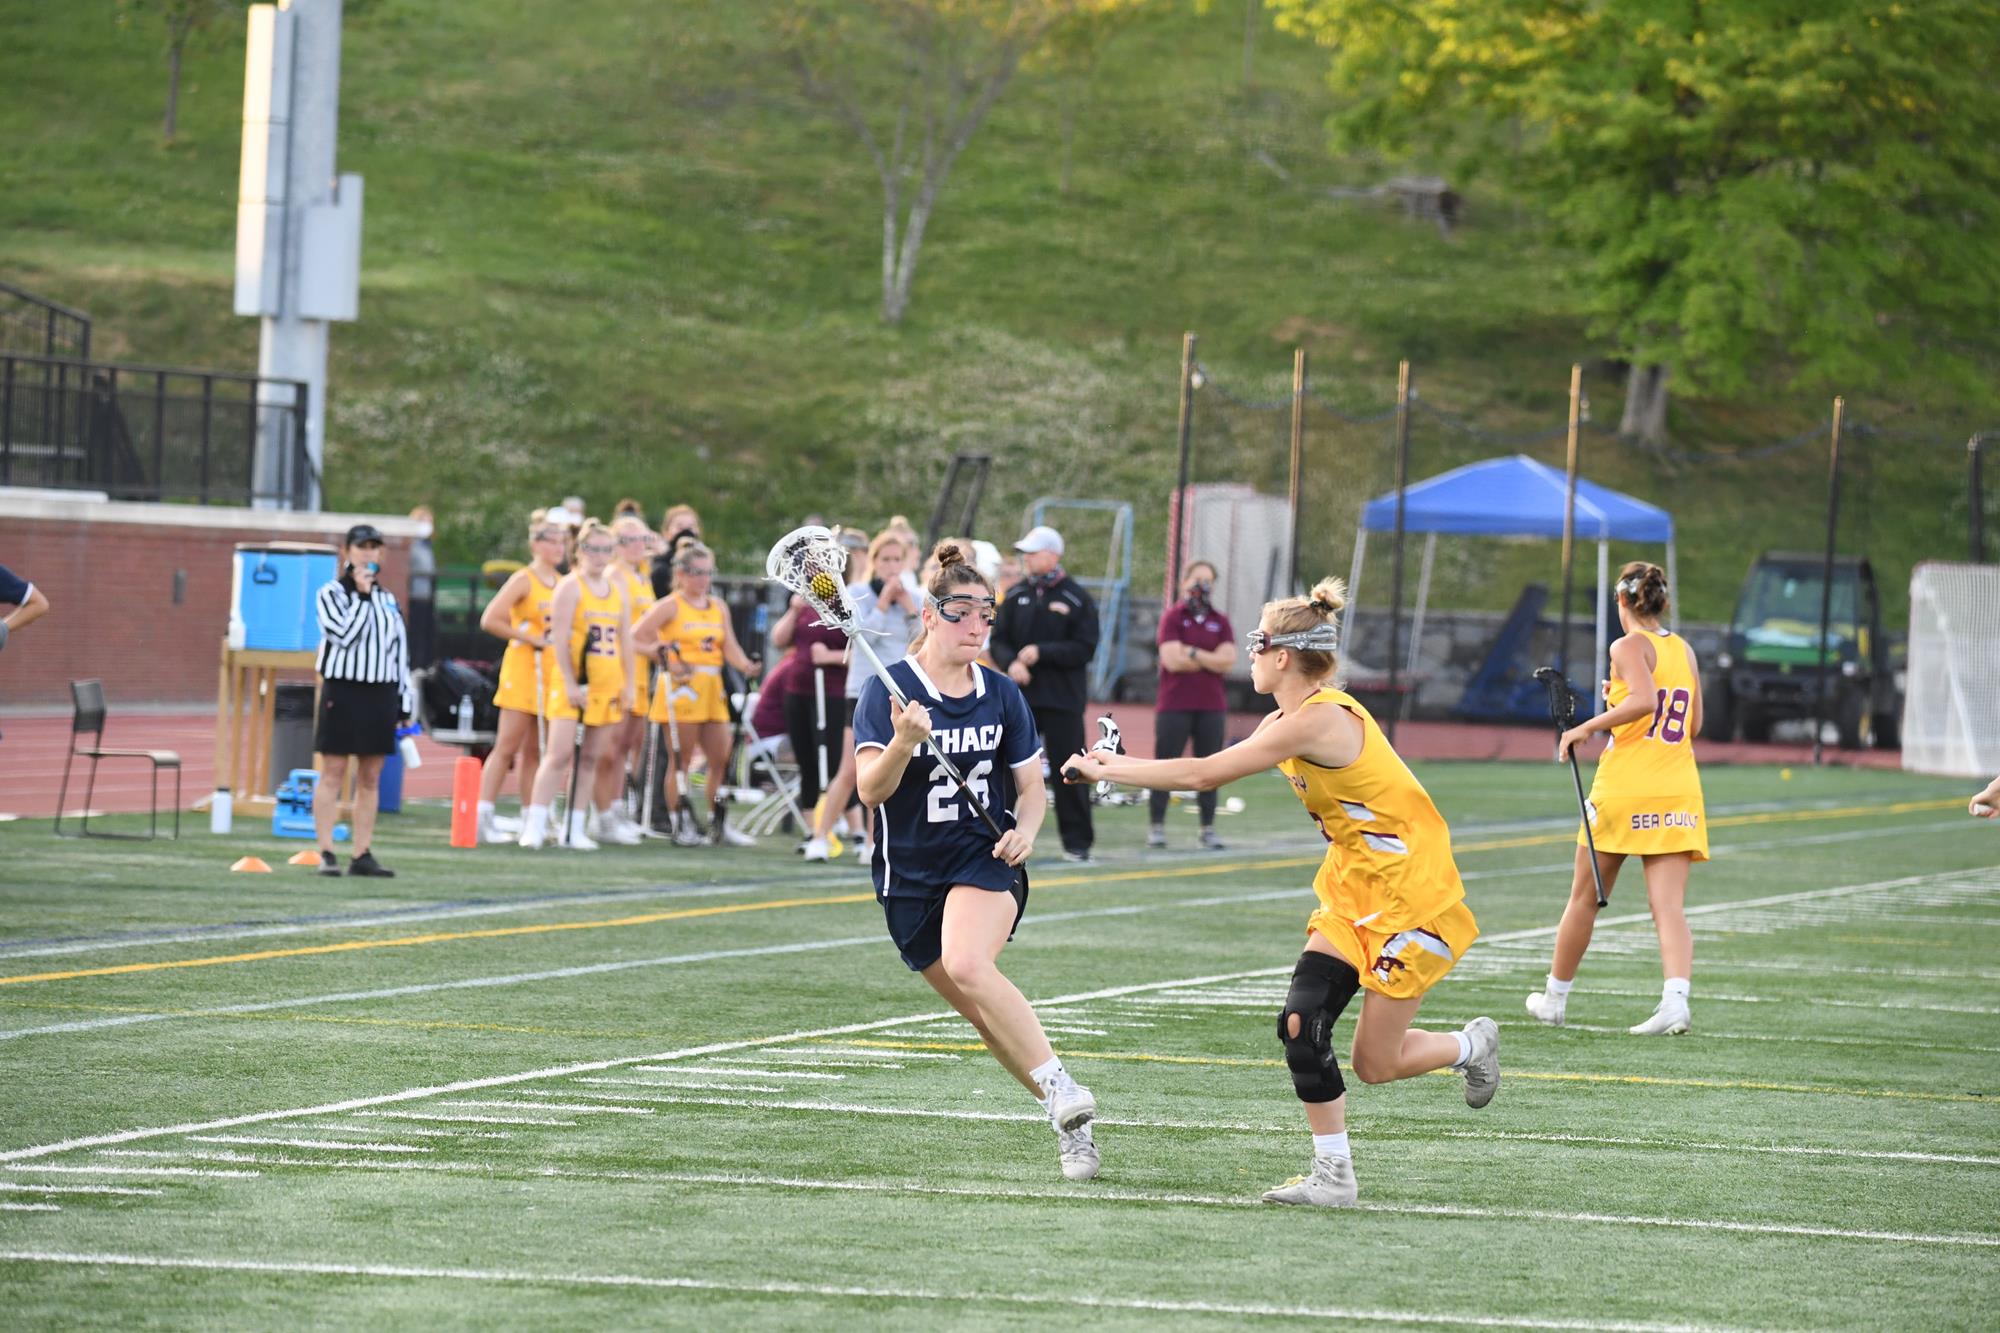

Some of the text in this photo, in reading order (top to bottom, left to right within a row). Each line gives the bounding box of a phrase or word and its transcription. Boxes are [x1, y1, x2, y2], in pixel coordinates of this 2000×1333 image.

[1645, 688, 1690, 743] 18
[927, 759, 993, 823] 26
[1631, 813, 1660, 830] SEA
